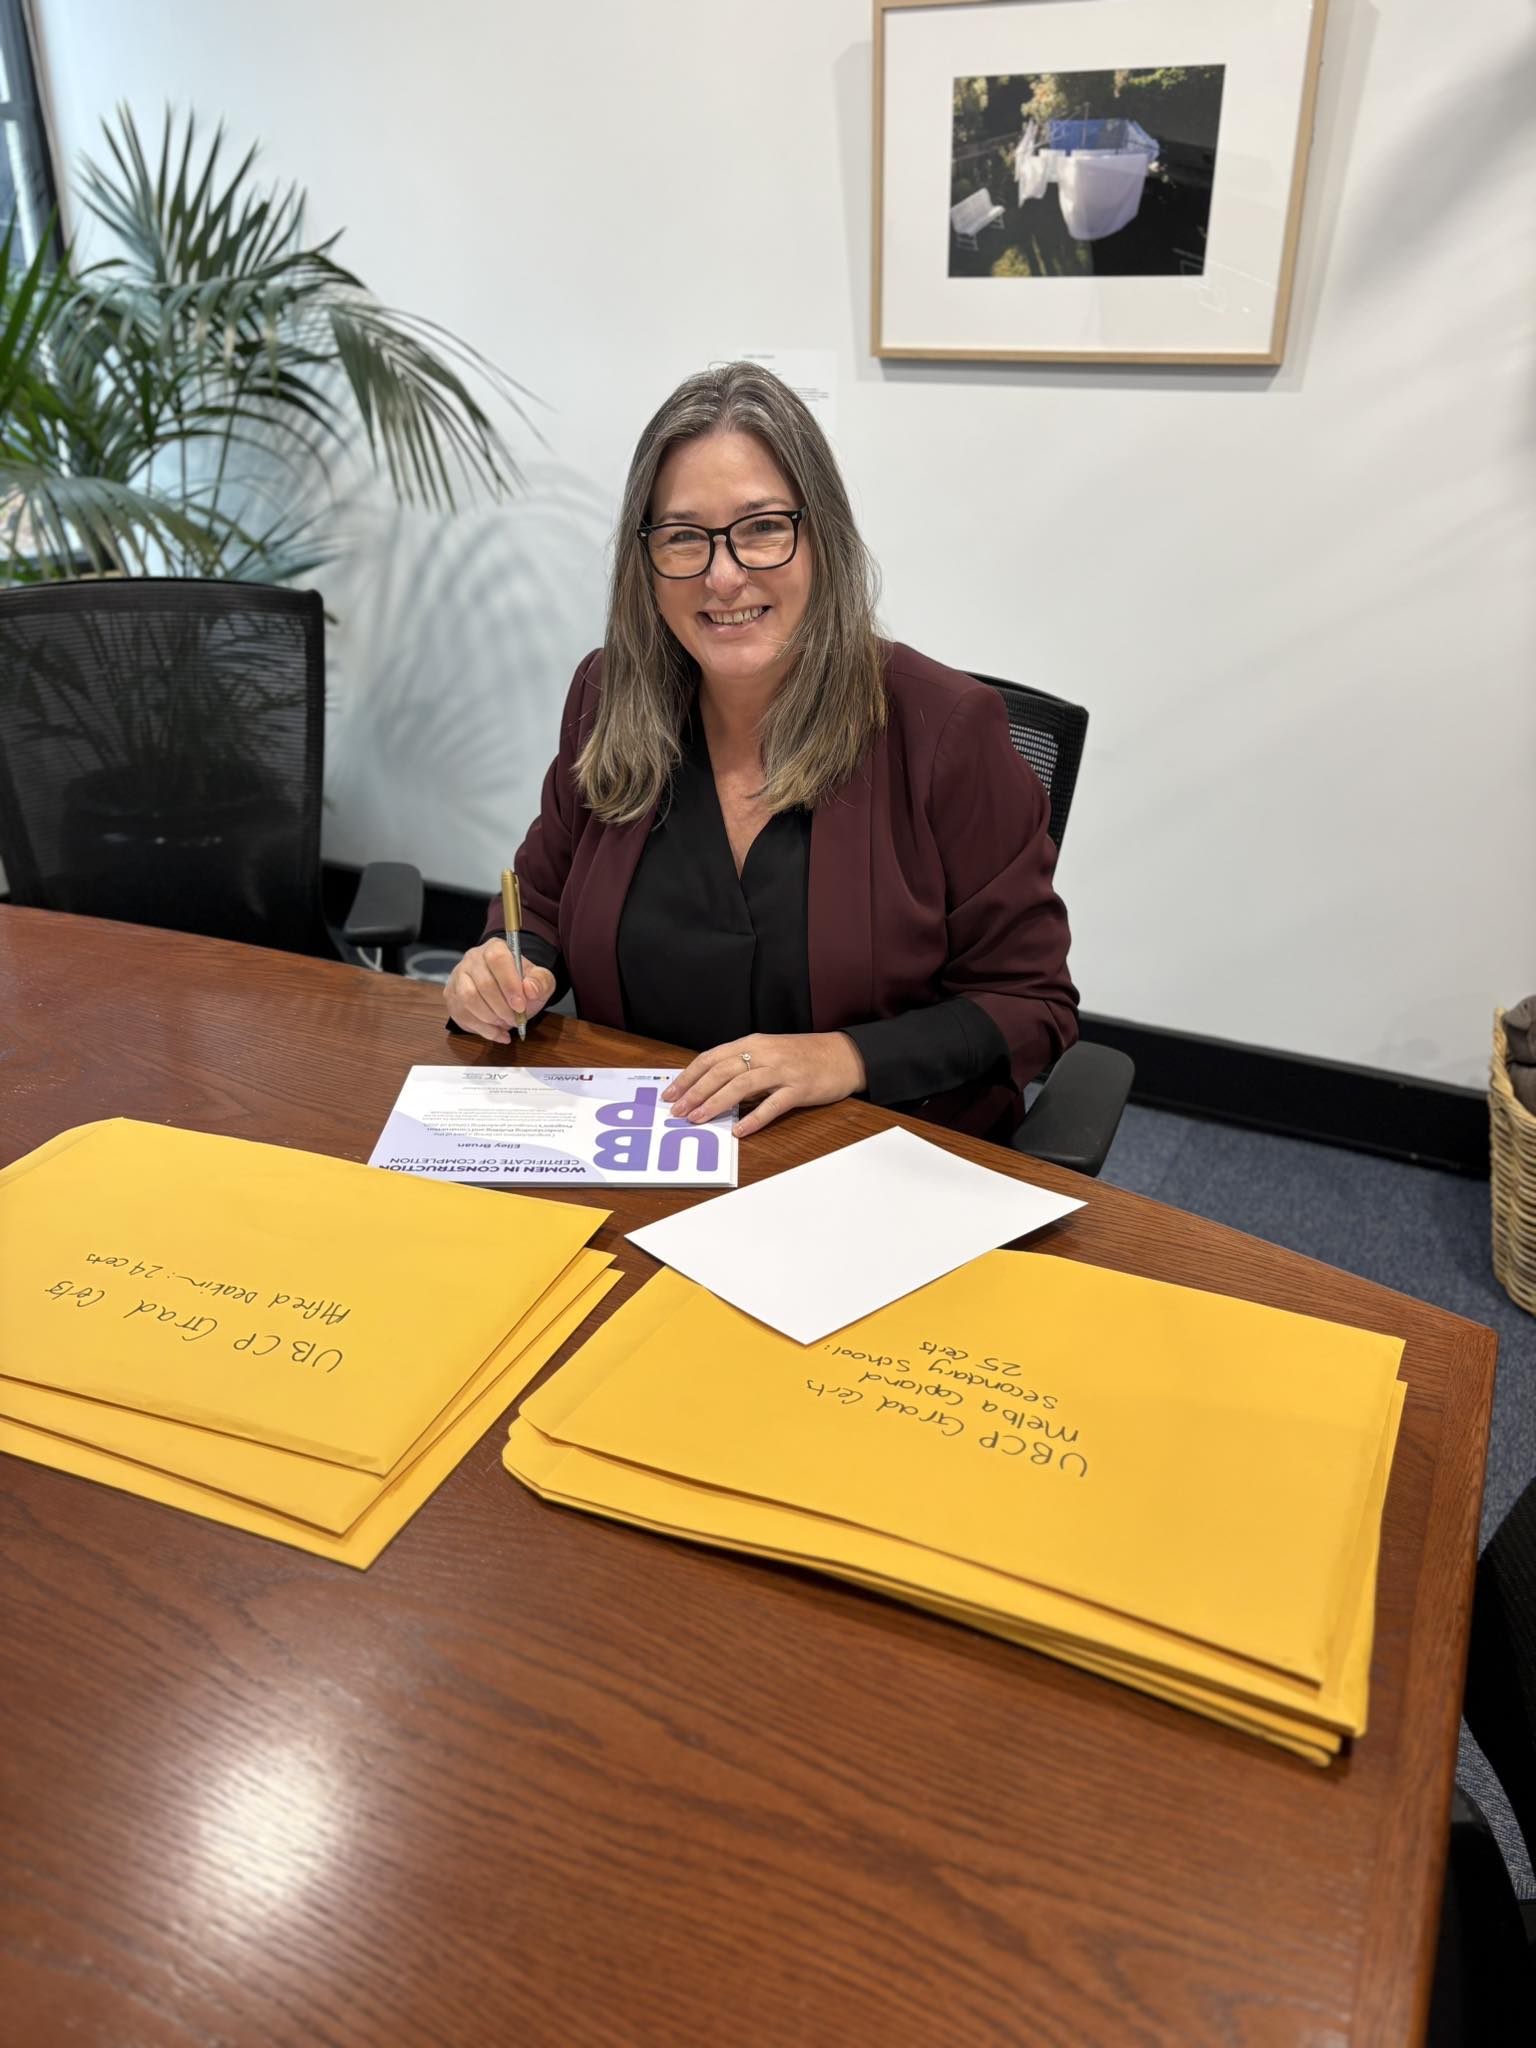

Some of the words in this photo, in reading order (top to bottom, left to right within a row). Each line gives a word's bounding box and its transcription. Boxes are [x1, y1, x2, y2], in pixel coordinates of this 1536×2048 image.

[593, 1128, 719, 1172] UB
[130, 1261, 164, 1279] 24
[122, 1299, 218, 1342] Grad
[267, 1292, 351, 1327] Alfred
[975, 1357, 1023, 1378] 25
[806, 1379, 864, 1405] Certs
[876, 1394, 965, 1437] Grad
[979, 1430, 1088, 1478] UBCP
